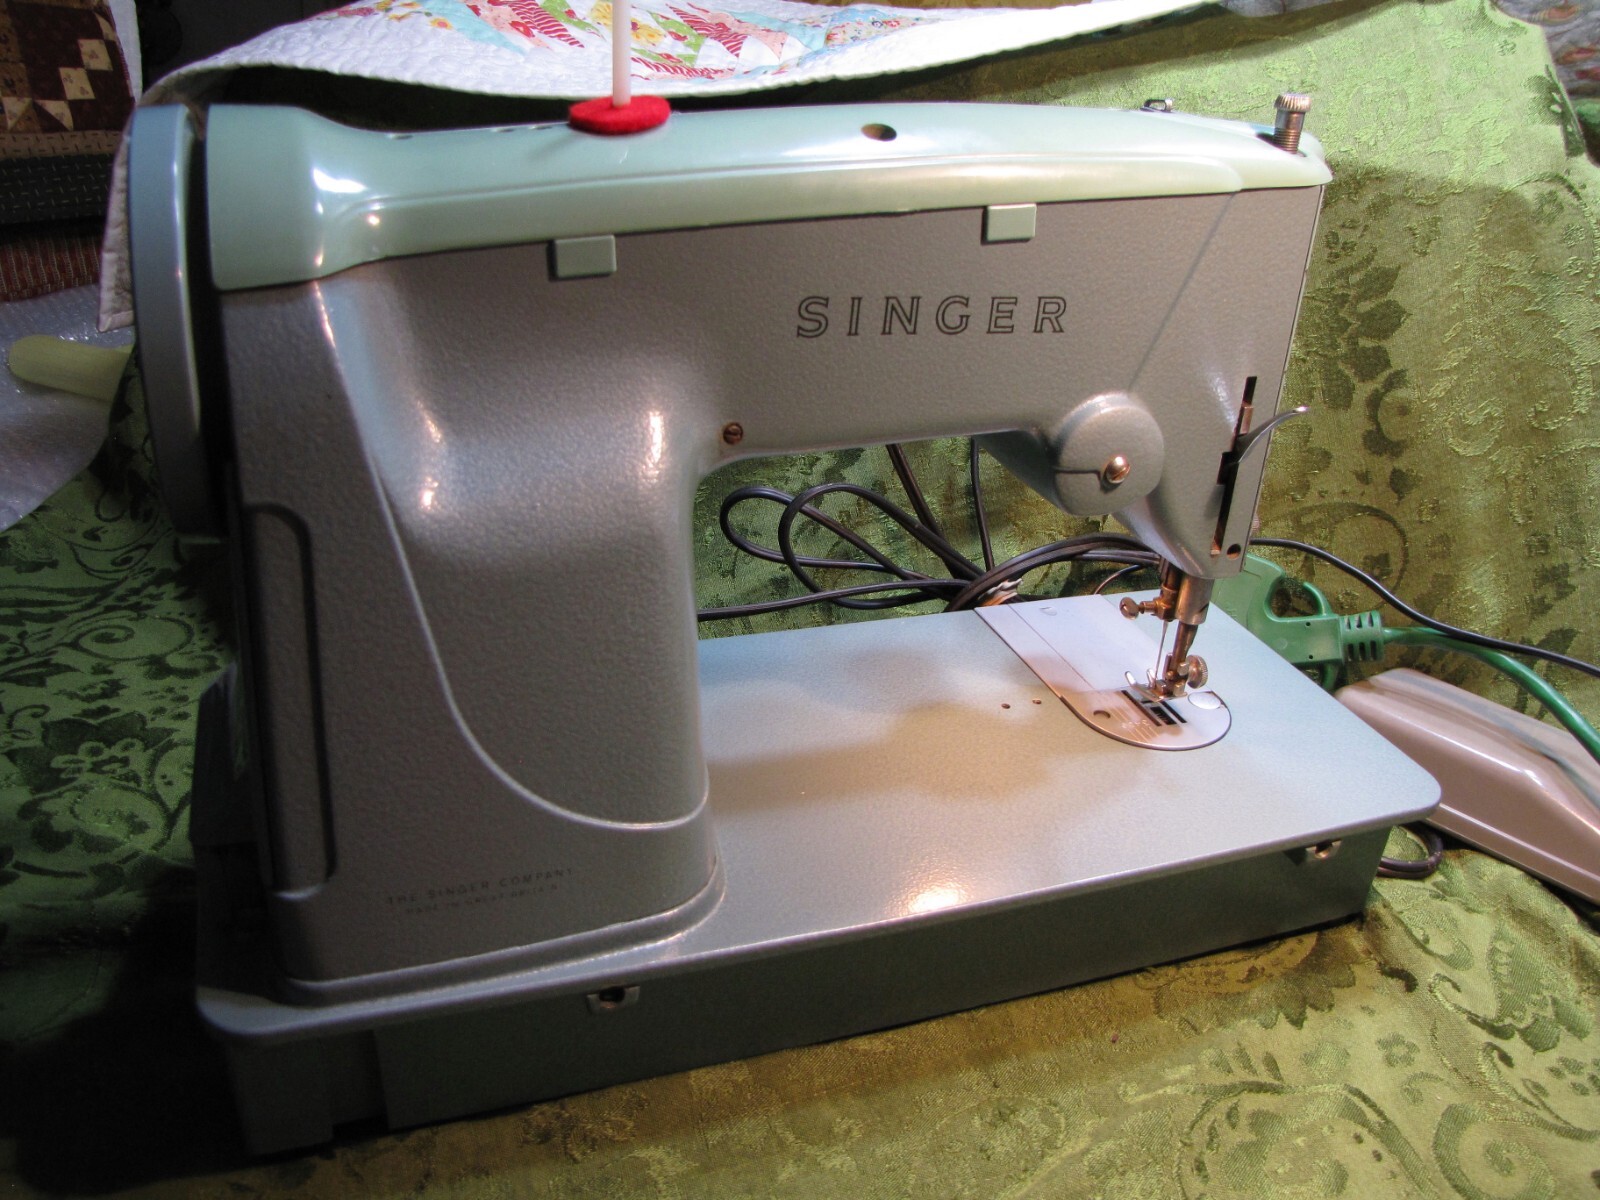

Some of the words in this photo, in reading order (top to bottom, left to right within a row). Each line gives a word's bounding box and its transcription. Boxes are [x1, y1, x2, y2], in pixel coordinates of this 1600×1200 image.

[796, 295, 1067, 338] SINGER
[386, 893, 417, 905] THE
[427, 880, 490, 900] SINGER
[498, 867, 573, 888] COMPANY
